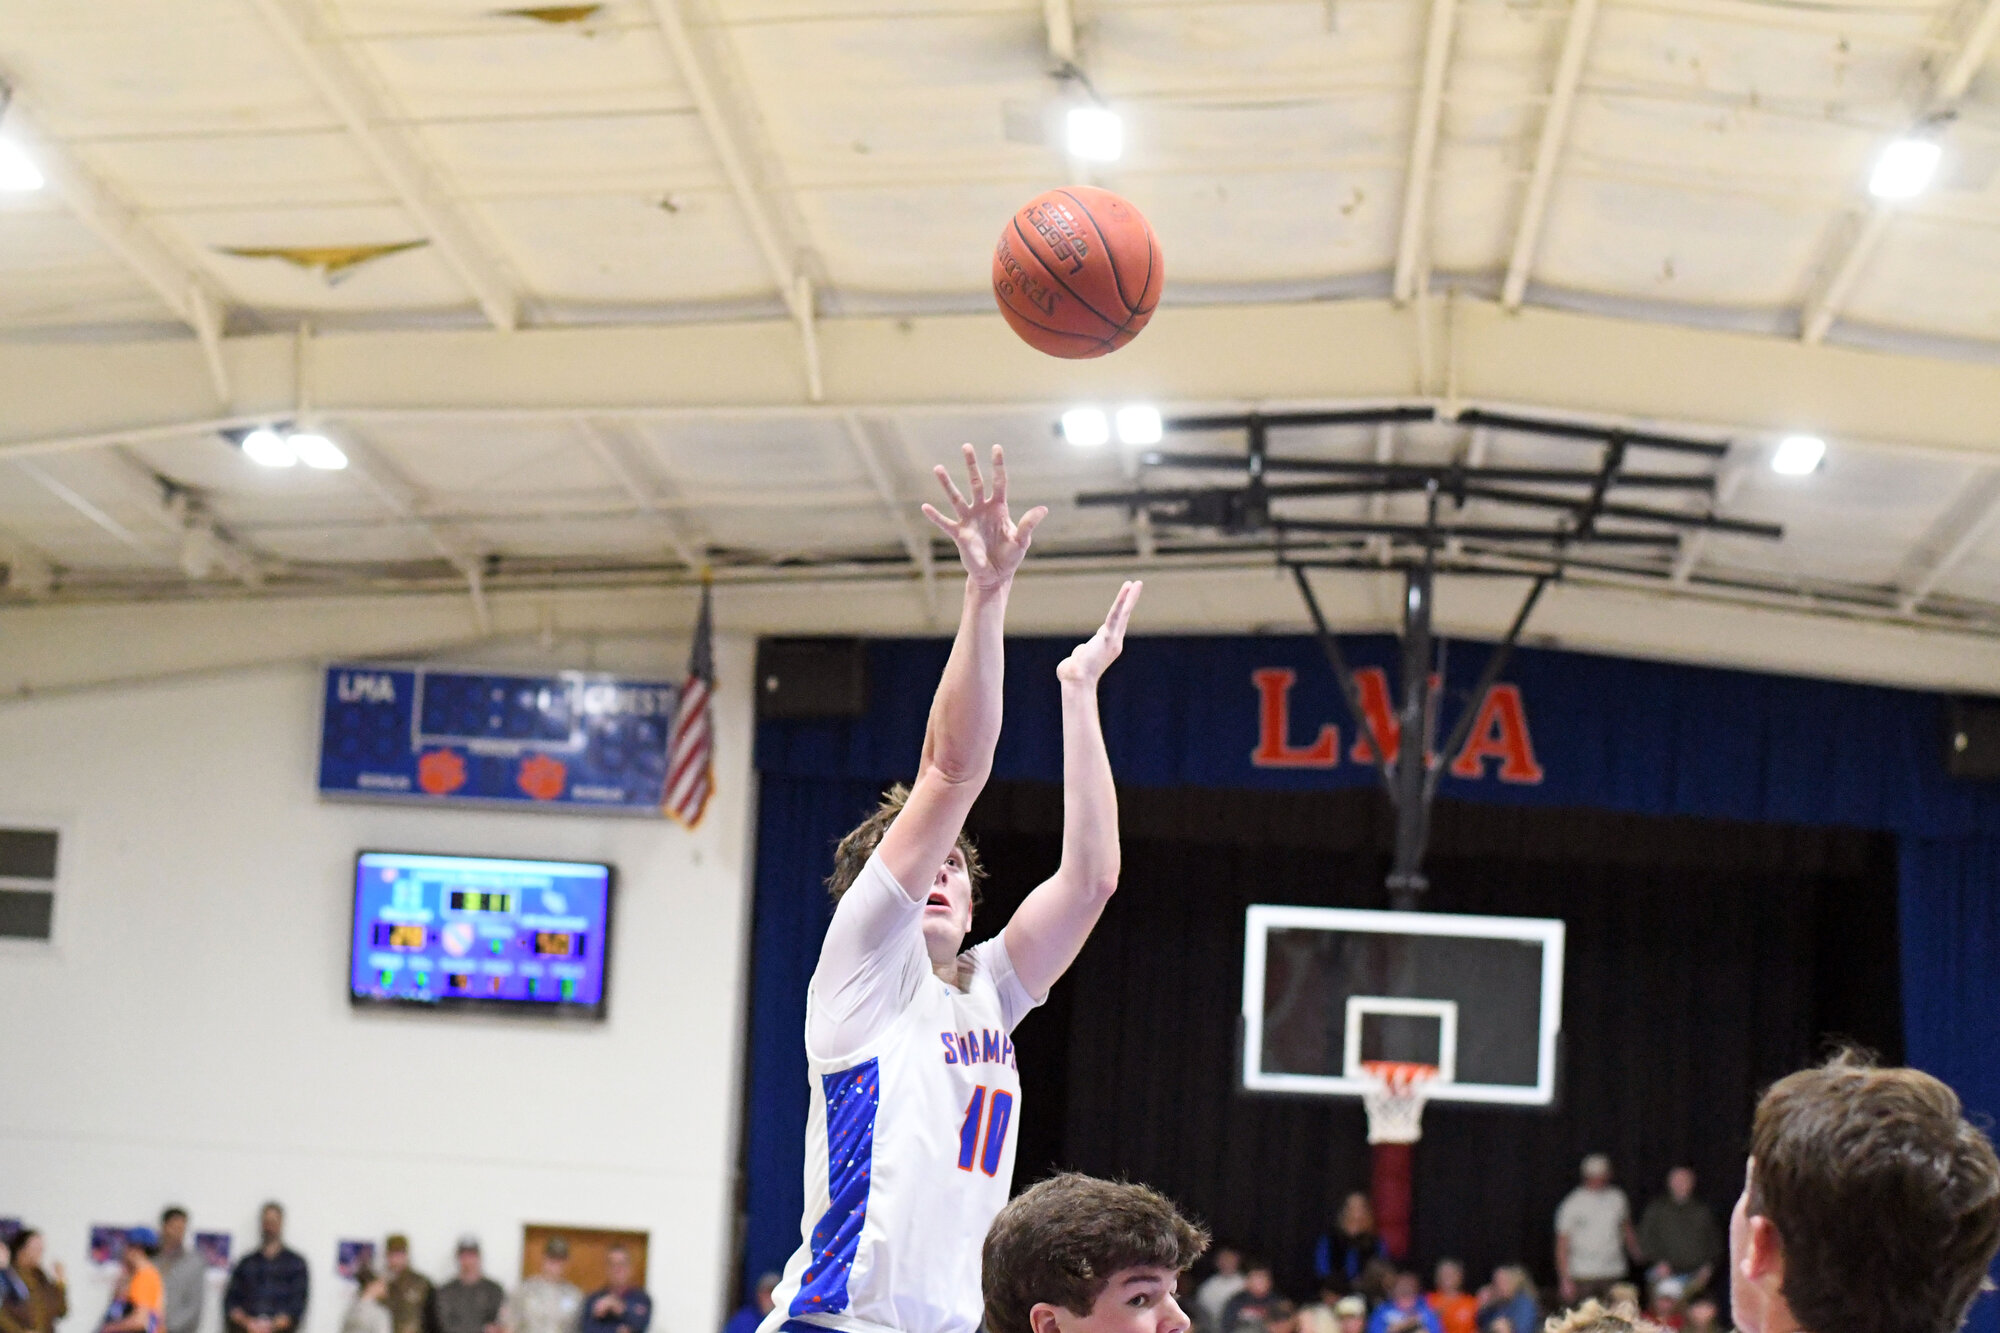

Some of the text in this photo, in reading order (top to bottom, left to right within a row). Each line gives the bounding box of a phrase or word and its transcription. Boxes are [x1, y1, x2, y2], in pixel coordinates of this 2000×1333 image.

[1024, 206, 1083, 275] LEGACY
[338, 673, 395, 703] LMA
[958, 1085, 1012, 1177] 10
